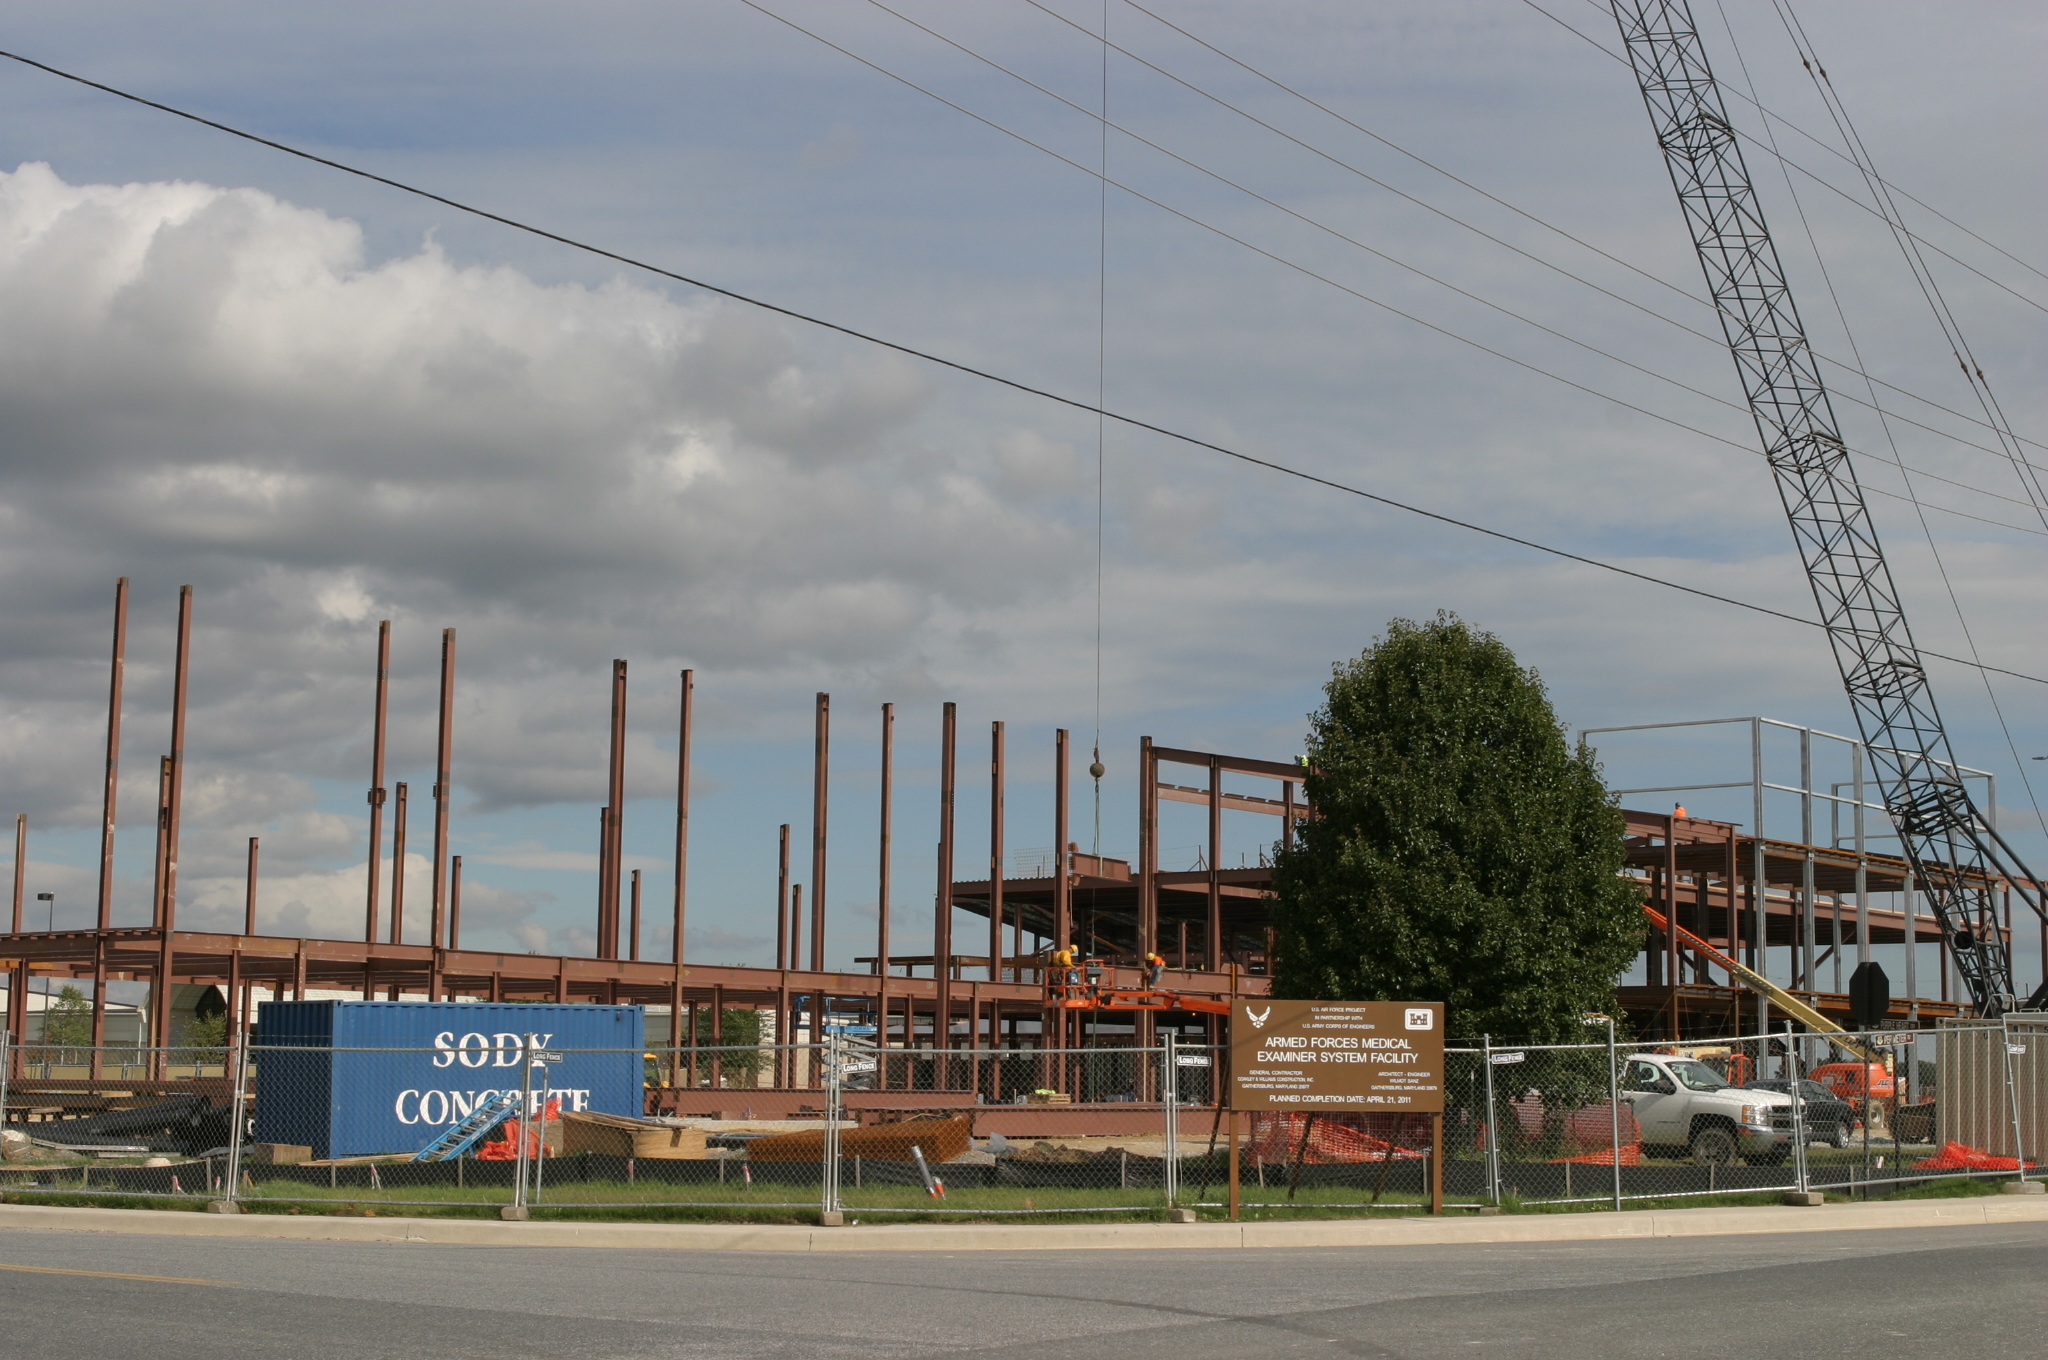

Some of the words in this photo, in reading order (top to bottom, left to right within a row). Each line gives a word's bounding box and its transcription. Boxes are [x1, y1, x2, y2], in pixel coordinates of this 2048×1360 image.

[1265, 1037, 1307, 1048] ARMED
[1311, 1037, 1358, 1048] FORCES
[1362, 1038, 1412, 1049] MEDICAL
[433, 1031, 553, 1068] SODY
[1257, 1051, 1317, 1062] EXAMINER
[1320, 1051, 1367, 1063] SYSTEM
[1370, 1052, 1418, 1064] FACILITY
[1269, 1094, 1300, 1103] PLANNED
[1302, 1095, 1345, 1103] COMPLETION
[1346, 1095, 1365, 1103] DATE:
[1366, 1096, 1385, 1104] APRIL
[1387, 1096, 1396, 1105] 21,
[1397, 1096, 1412, 1104] 2011
